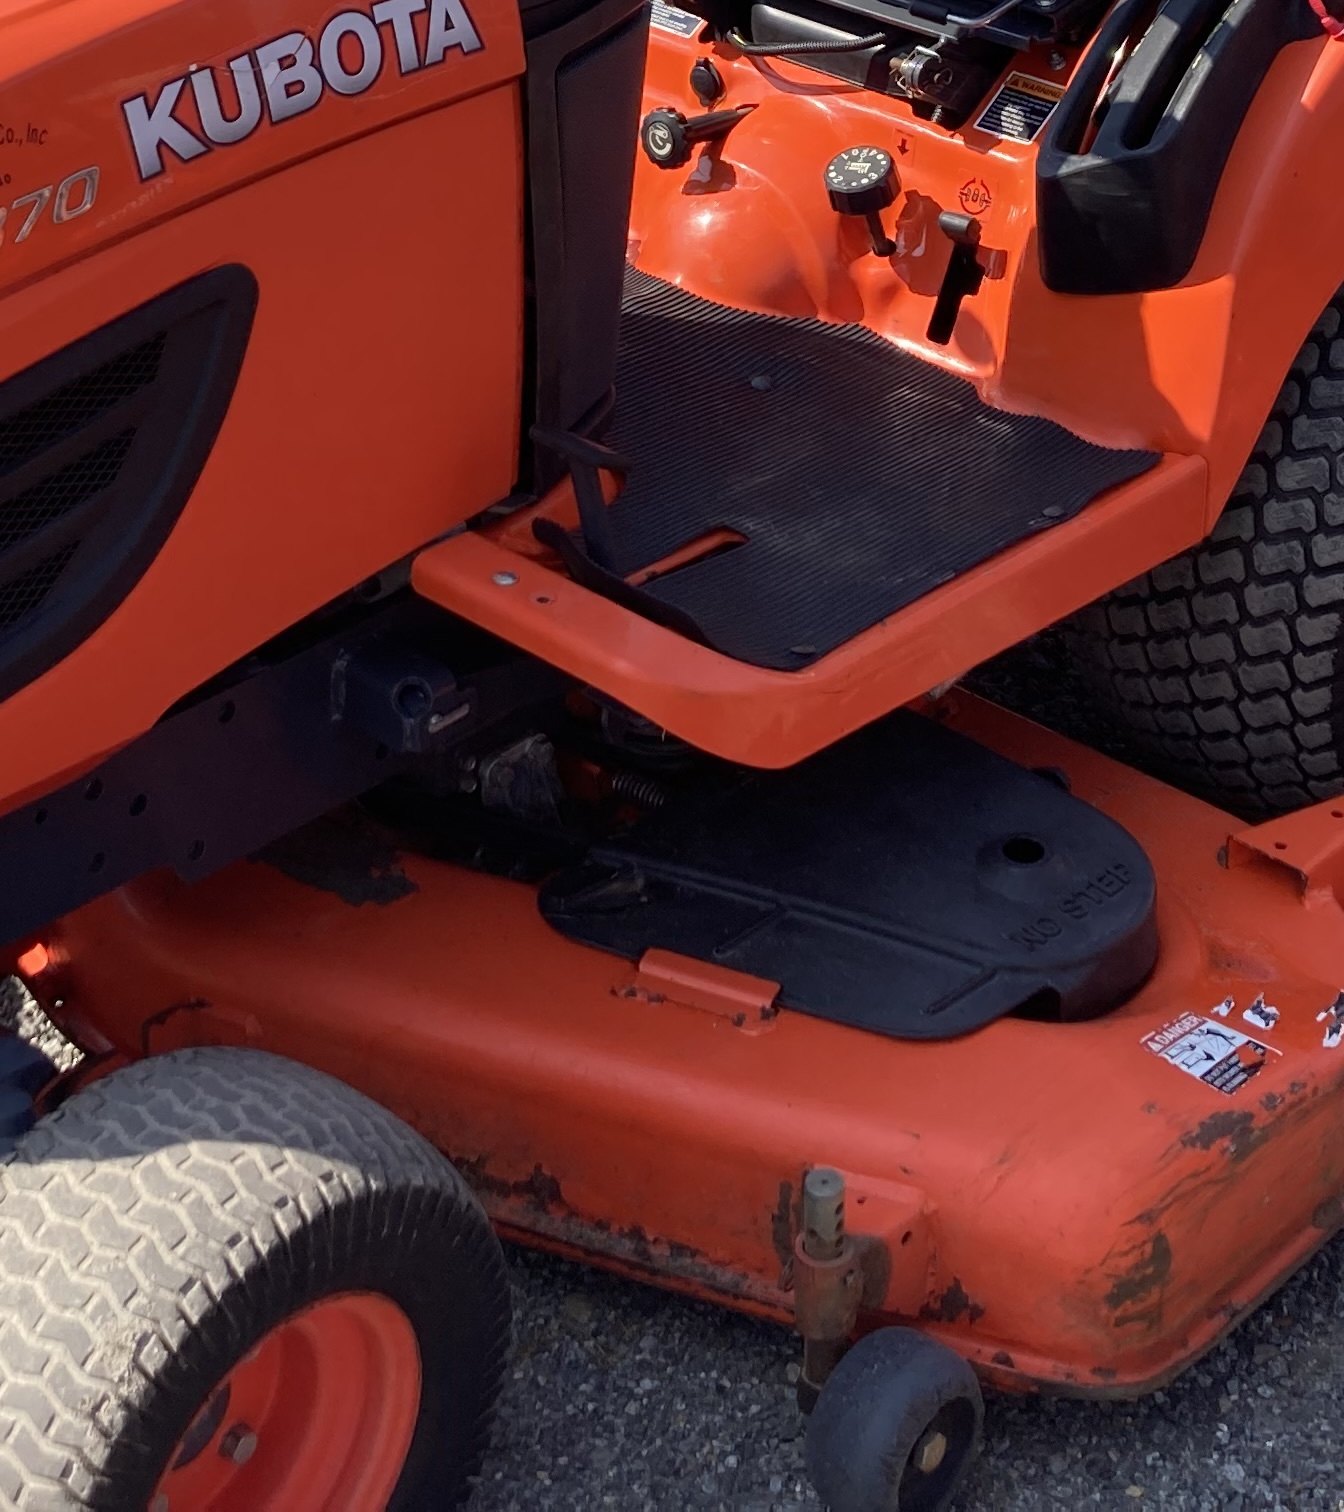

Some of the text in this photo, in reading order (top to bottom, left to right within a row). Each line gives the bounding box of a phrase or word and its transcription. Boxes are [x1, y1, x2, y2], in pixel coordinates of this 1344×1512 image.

[1021, 80, 1063, 99] WARNING
[27, 122, 49, 147] Inc
[1008, 863, 1132, 953] NO STEP
[1154, 1014, 1203, 1045] DANGER
